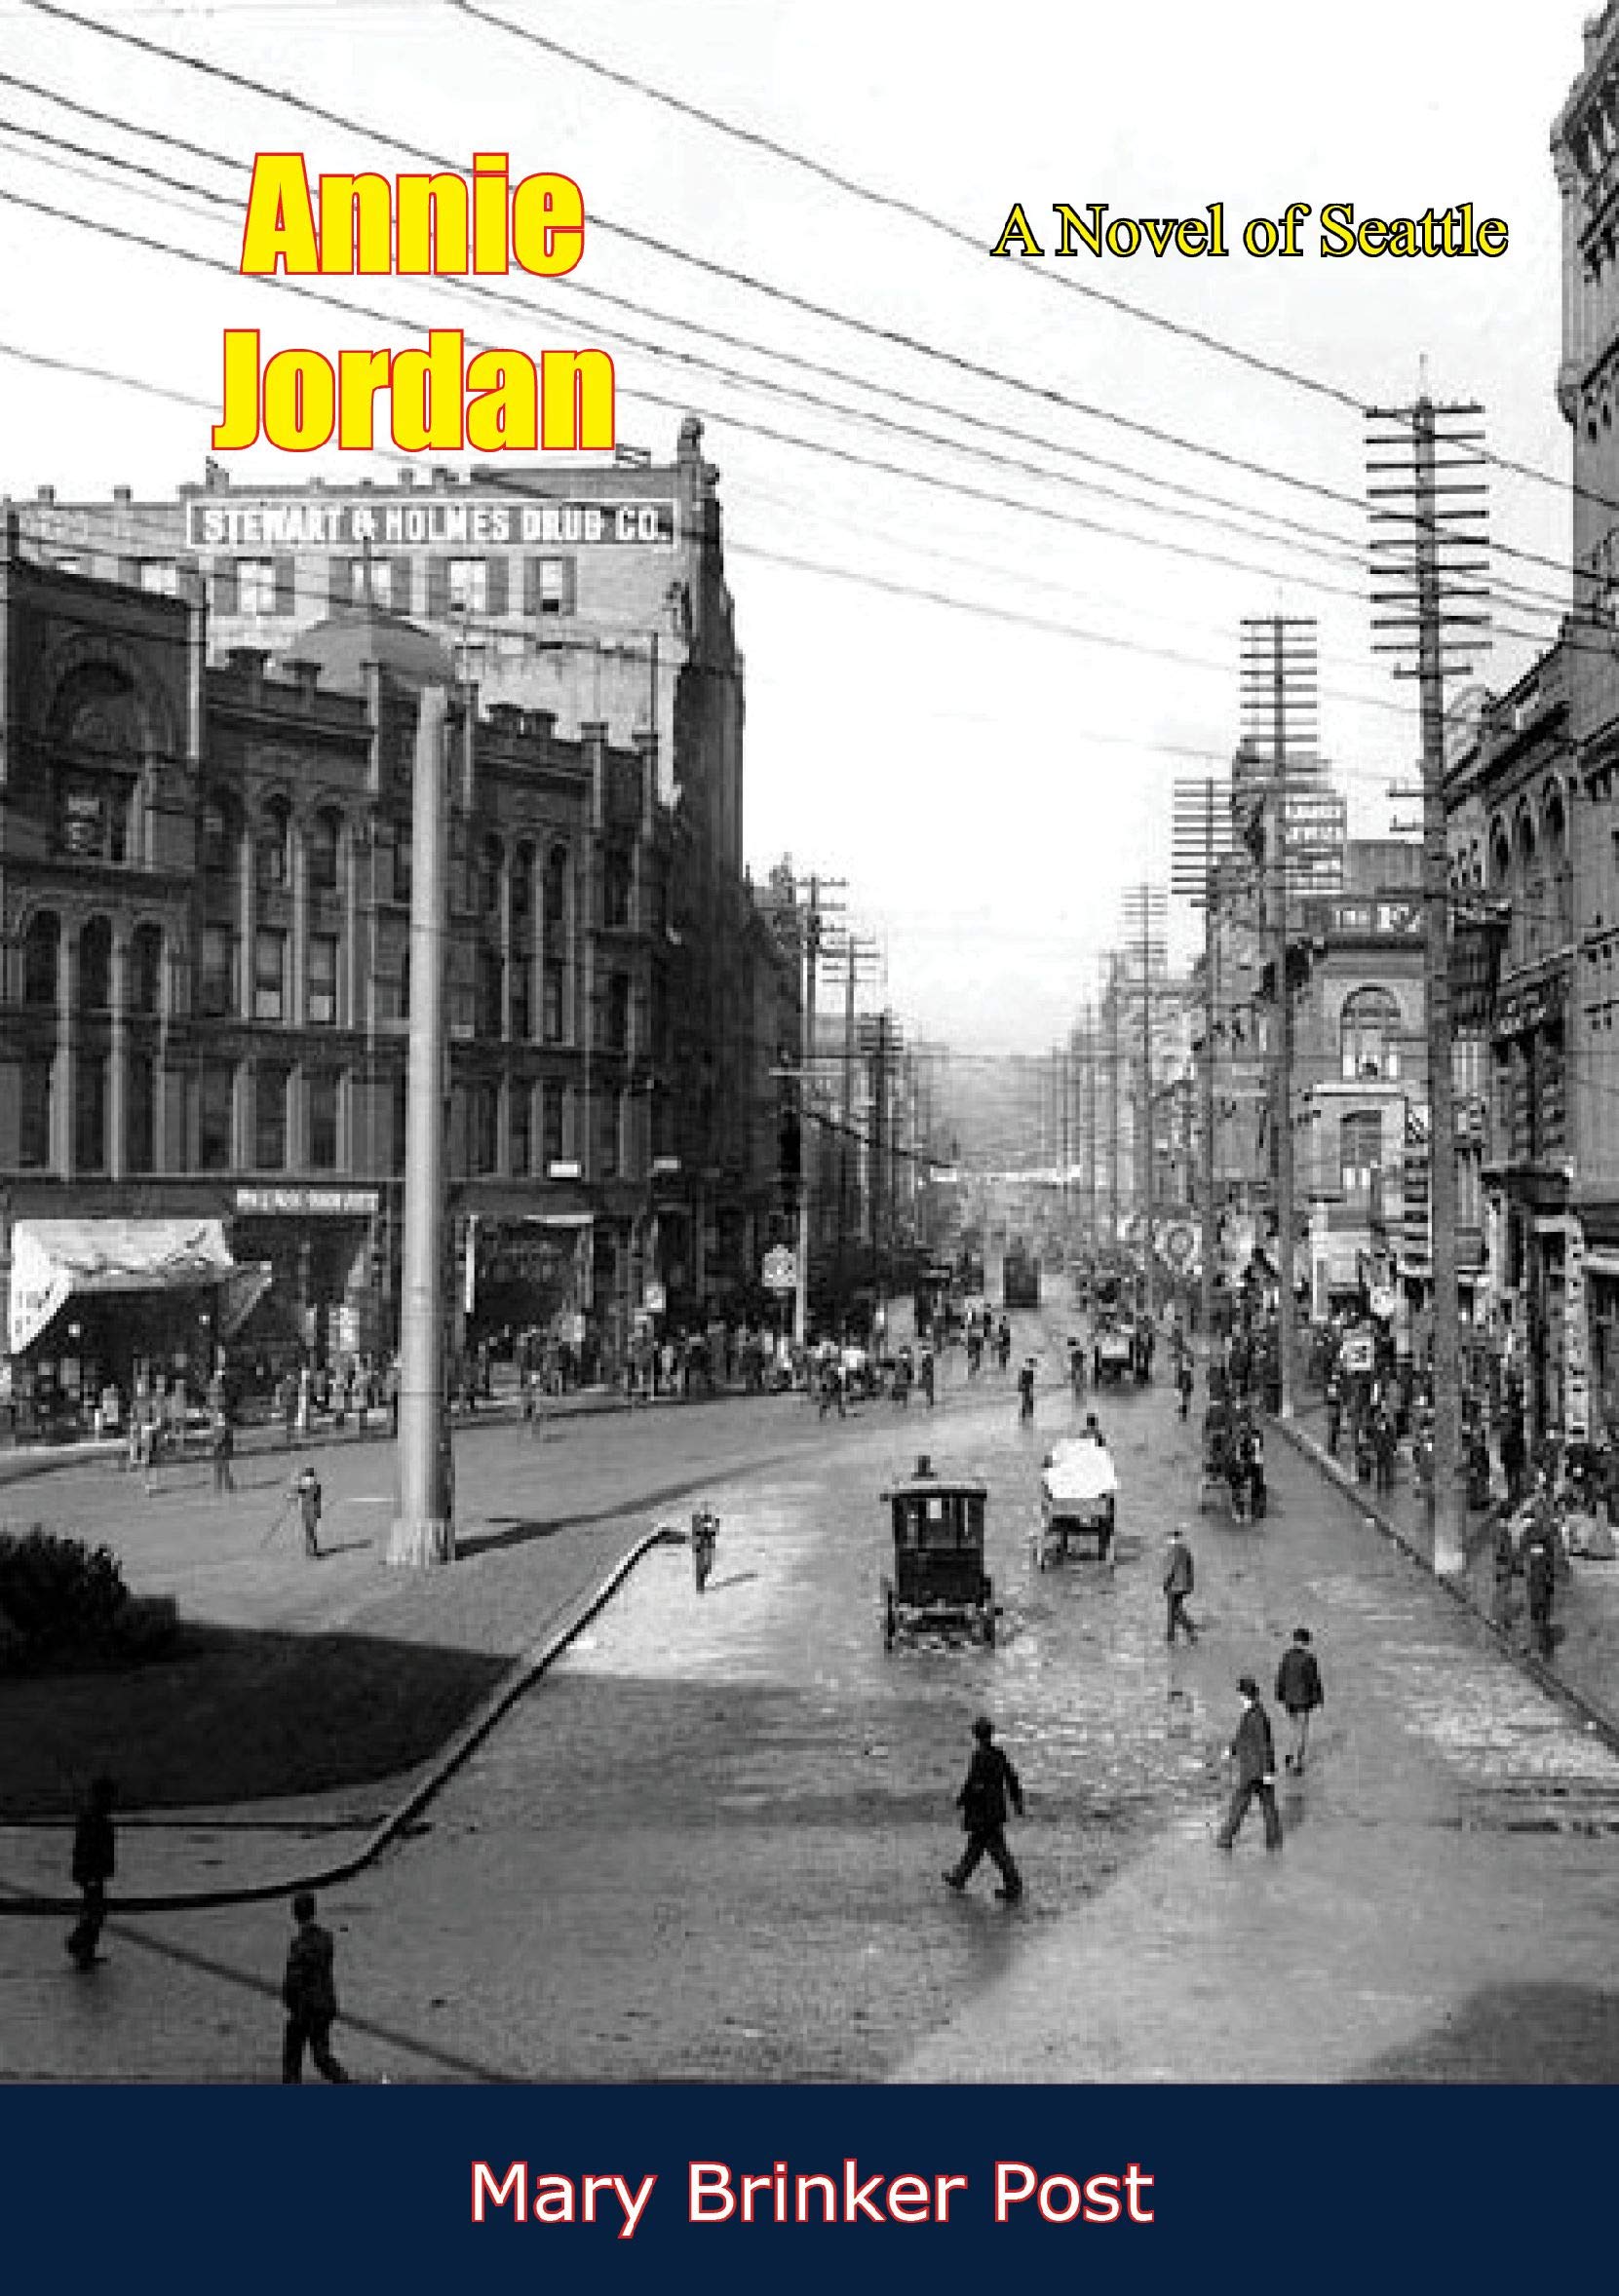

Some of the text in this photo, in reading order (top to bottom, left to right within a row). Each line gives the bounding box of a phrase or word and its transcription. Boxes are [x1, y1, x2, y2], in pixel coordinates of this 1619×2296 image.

[202, 509, 343, 541] STEWART
[351, 509, 376, 540] &
[386, 509, 510, 541] HOLMES
[615, 509, 671, 541] CO.
